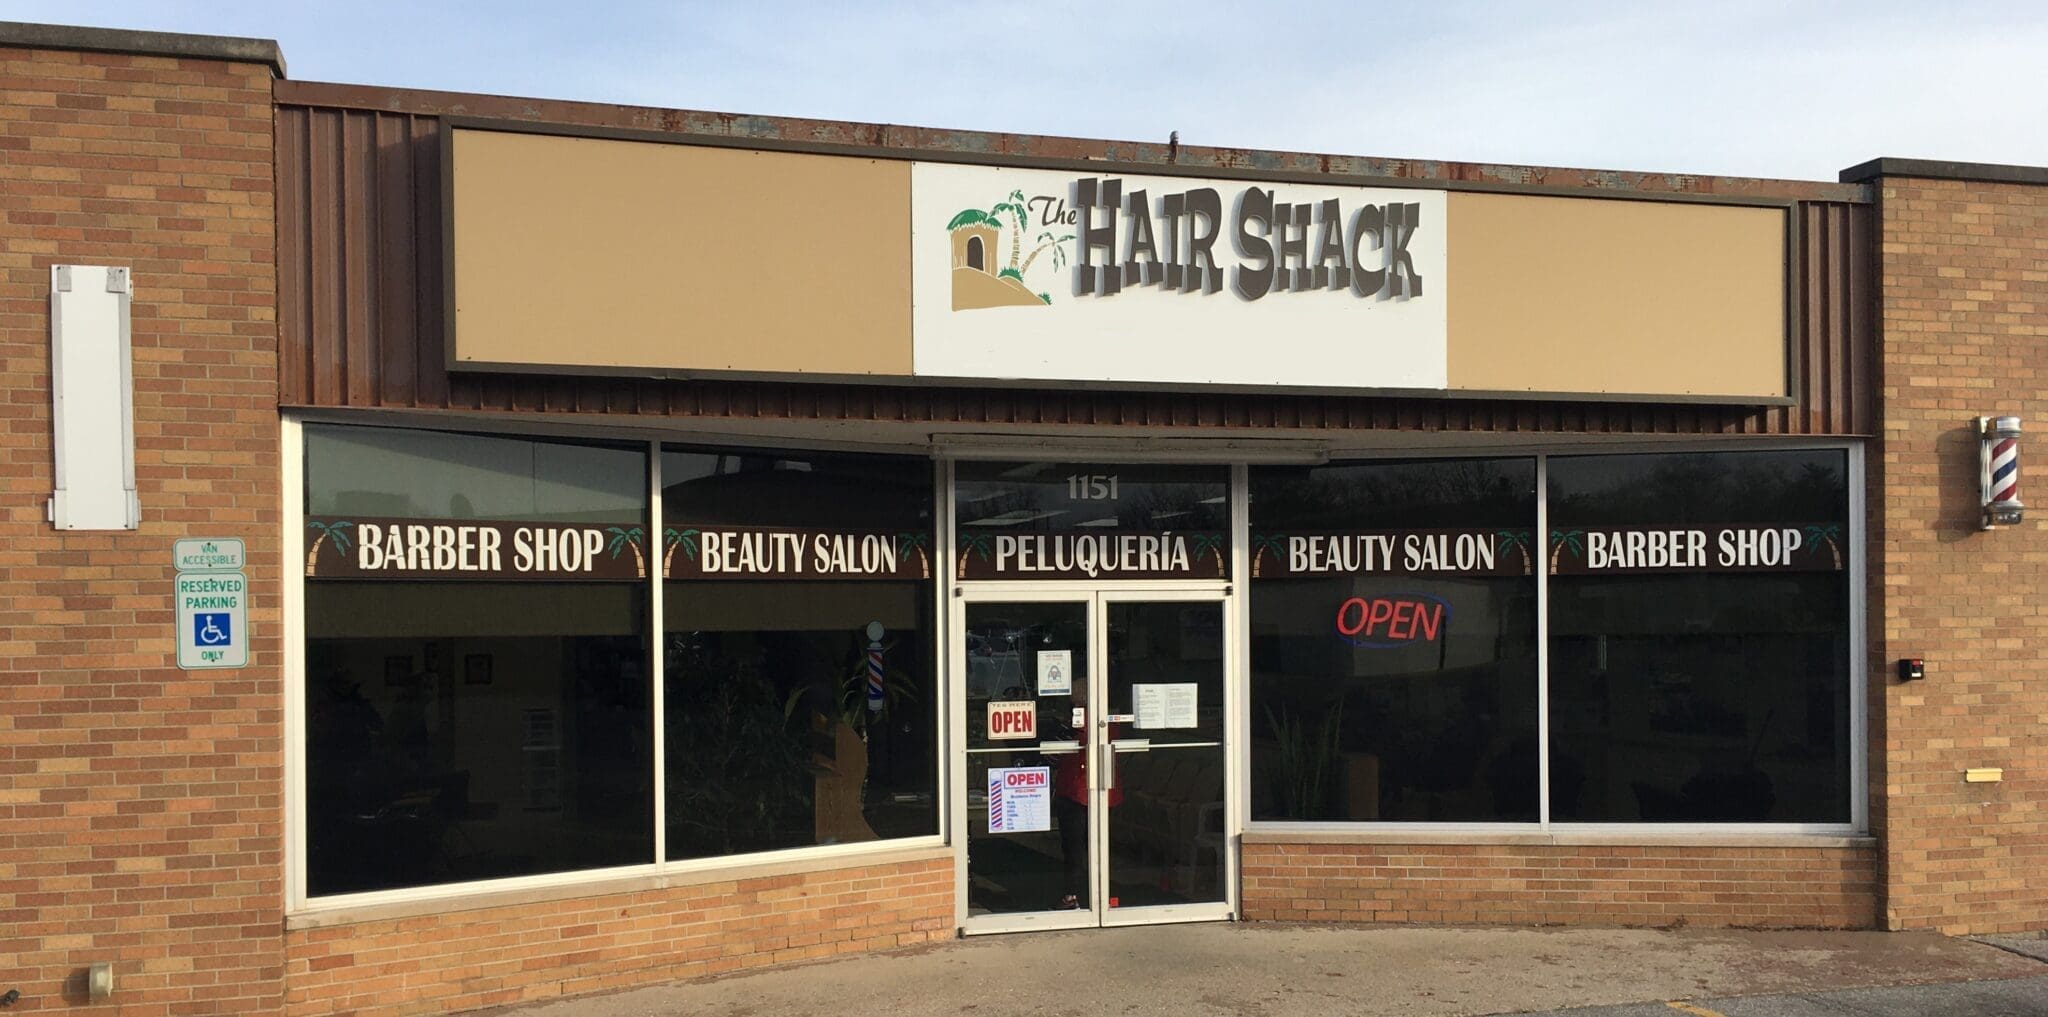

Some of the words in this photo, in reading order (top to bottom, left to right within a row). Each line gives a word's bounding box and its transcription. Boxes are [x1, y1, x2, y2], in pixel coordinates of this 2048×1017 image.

[1029, 195, 1076, 226] The
[1075, 177, 1223, 298] HAIR
[1233, 186, 1423, 301] SHACK
[1066, 474, 1119, 500] 1151
[183, 555, 237, 565] ACCESSIBLE
[201, 544, 218, 554] VAN
[357, 524, 502, 572] BARBER
[513, 527, 604, 572] SHOP
[701, 532, 807, 573] BEAUTY
[814, 533, 898, 575] SALON
[995, 531, 1190, 578] PELUQUERÍA
[1289, 534, 1395, 572] BEAUTY
[1403, 534, 1495, 572] SALON
[1587, 530, 1706, 569] BARBER
[1718, 528, 1803, 567] SHOP
[181, 580, 242, 593] RESERVED
[186, 597, 237, 609] PARKING
[1337, 597, 1442, 642] OPEN
[201, 651, 224, 661] ONLY
[991, 710, 1033, 734] OPEN
[1007, 773, 1045, 786] OPEN
